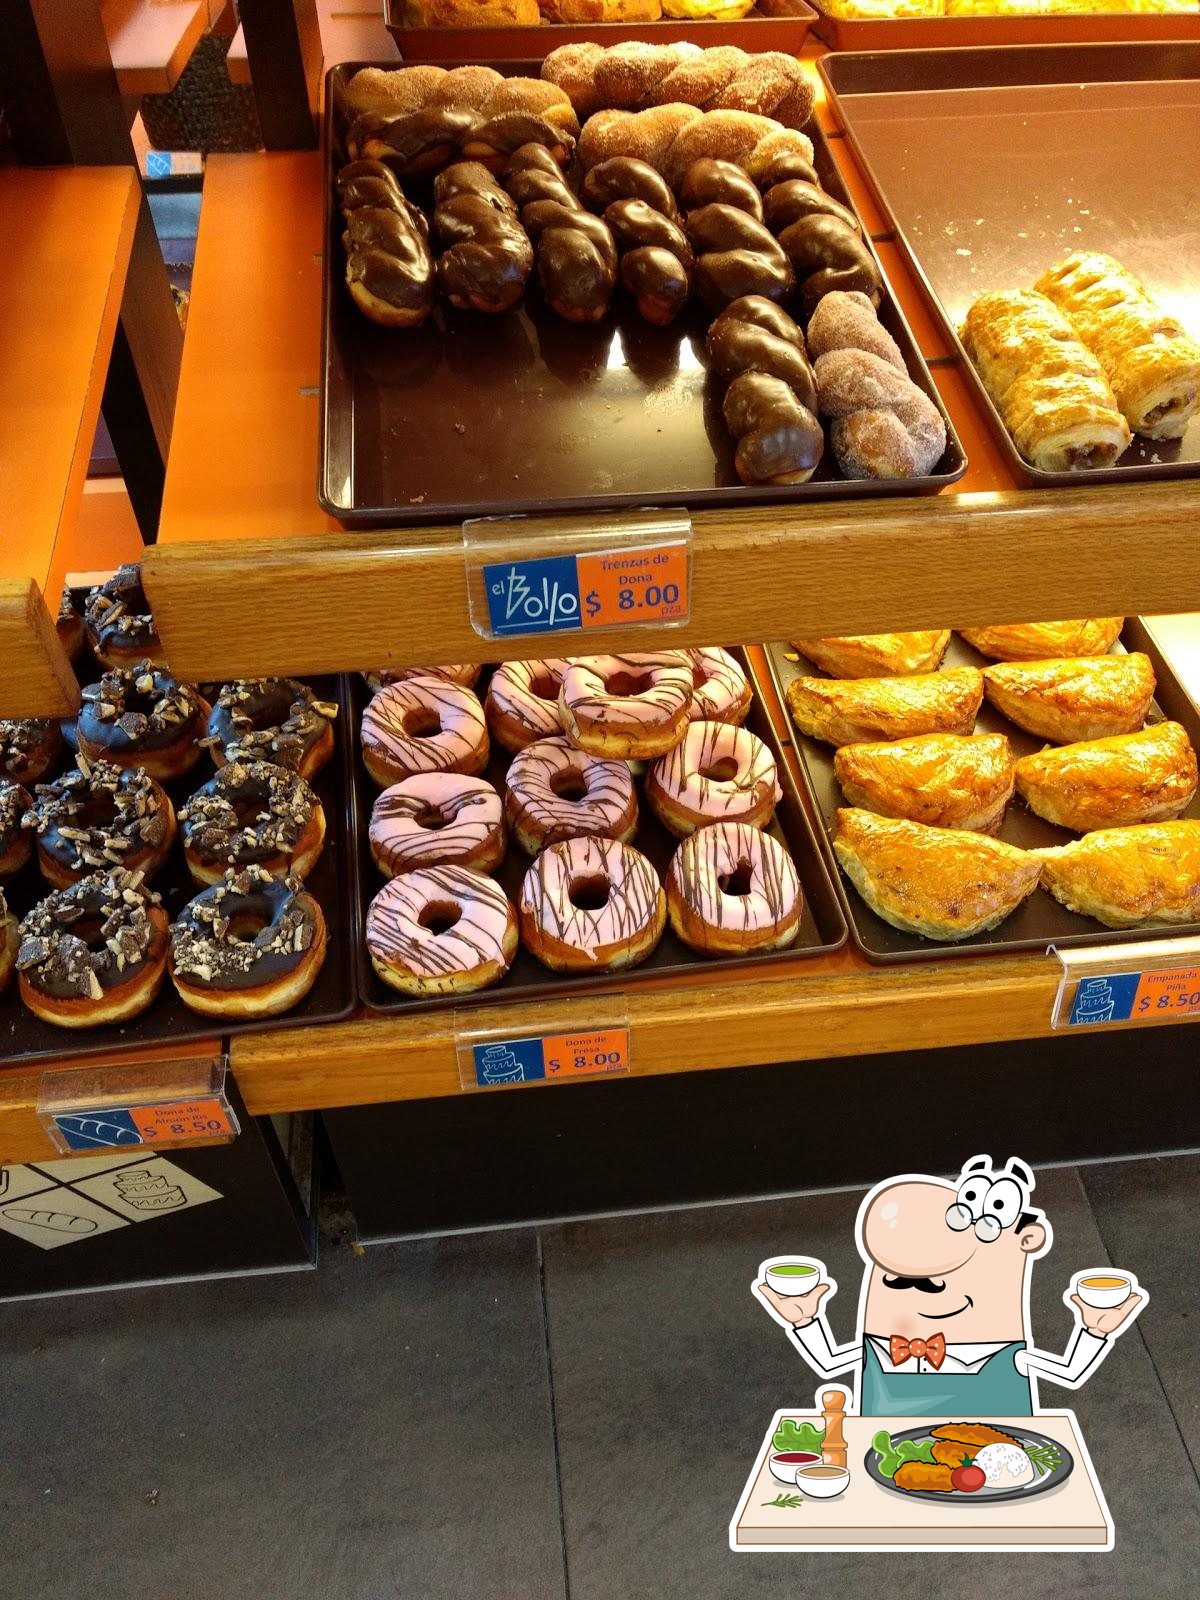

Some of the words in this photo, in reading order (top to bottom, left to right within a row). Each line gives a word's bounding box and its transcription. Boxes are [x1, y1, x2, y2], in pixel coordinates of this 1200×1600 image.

[600, 558, 649, 570] Trenzas
[653, 554, 669, 565] de
[619, 574, 652, 585] Dona
[491, 580, 505, 596] el
[506, 566, 579, 625] Bollo
[585, 590, 601, 617] $
[618, 584, 679, 609] 8.00
[1148, 972, 1197, 982] Empanada
[1138, 996, 1151, 1012] $
[1157, 992, 1200, 1009] 8.50
[565, 1039, 592, 1047] Dona
[593, 1036, 607, 1044] de
[548, 1059, 561, 1072] $
[574, 1052, 621, 1068] 8.00
[155, 1108, 184, 1117] Dona
[187, 1106, 200, 1114] de
[143, 1126, 157, 1137] $
[170, 1120, 221, 1134] 8.50
